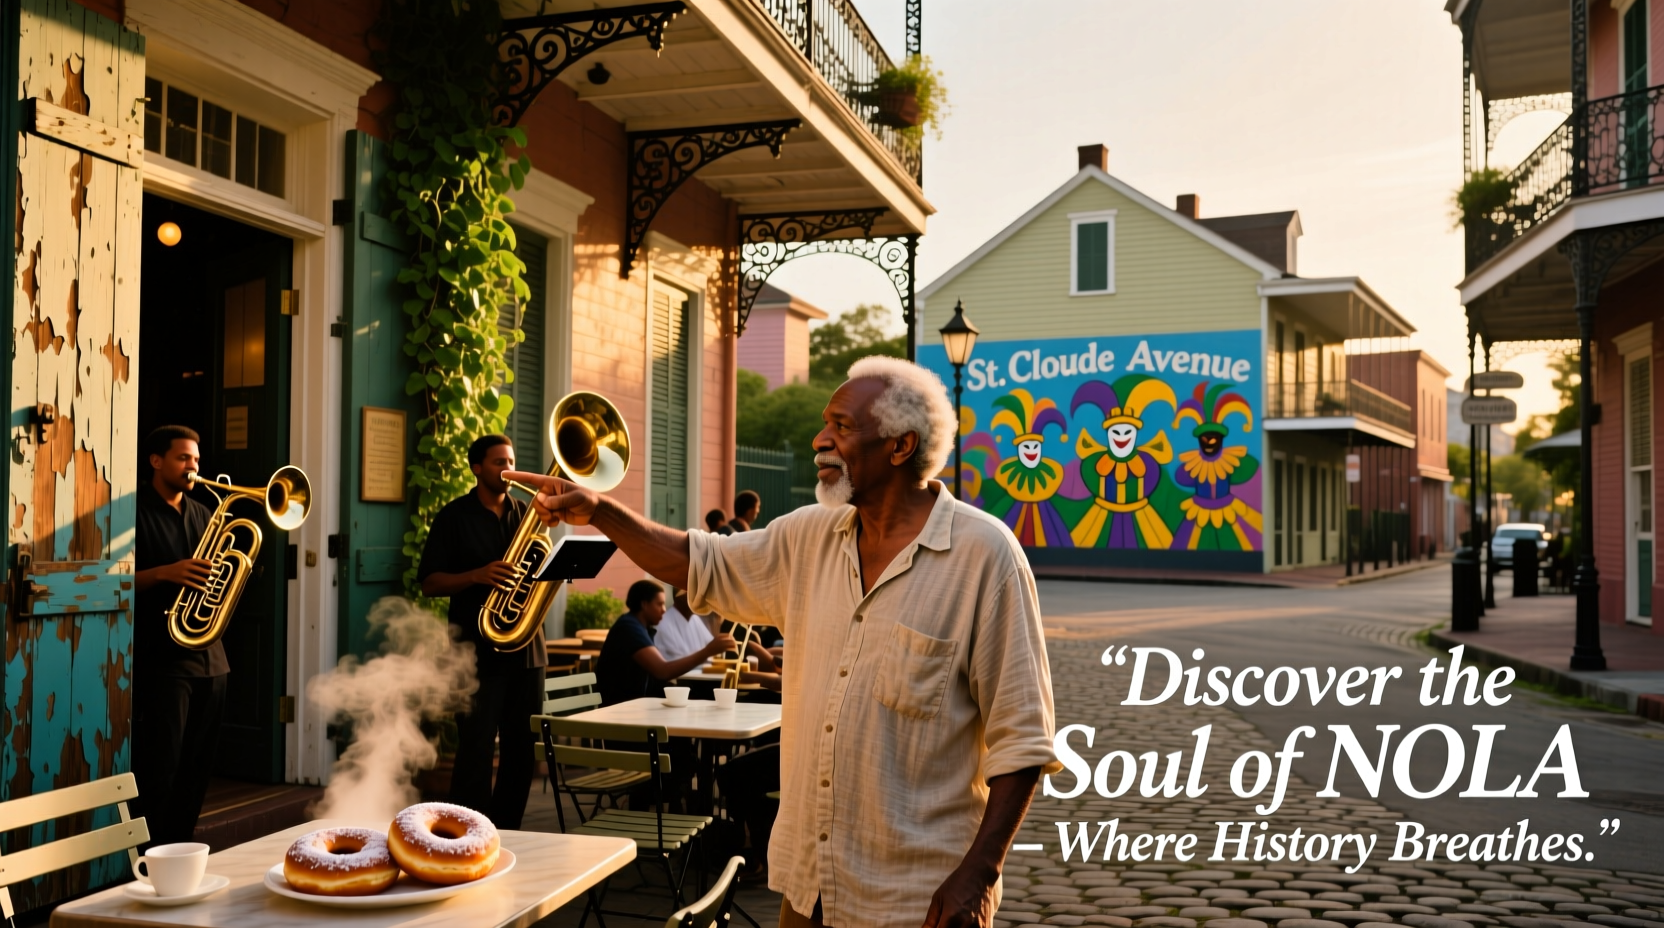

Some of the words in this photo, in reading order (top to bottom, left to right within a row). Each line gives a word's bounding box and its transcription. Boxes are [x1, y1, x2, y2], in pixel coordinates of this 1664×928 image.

[966, 358, 1006, 391] St.
[1008, 342, 1115, 383] Cloude
[1125, 340, 1250, 382] Avenue
